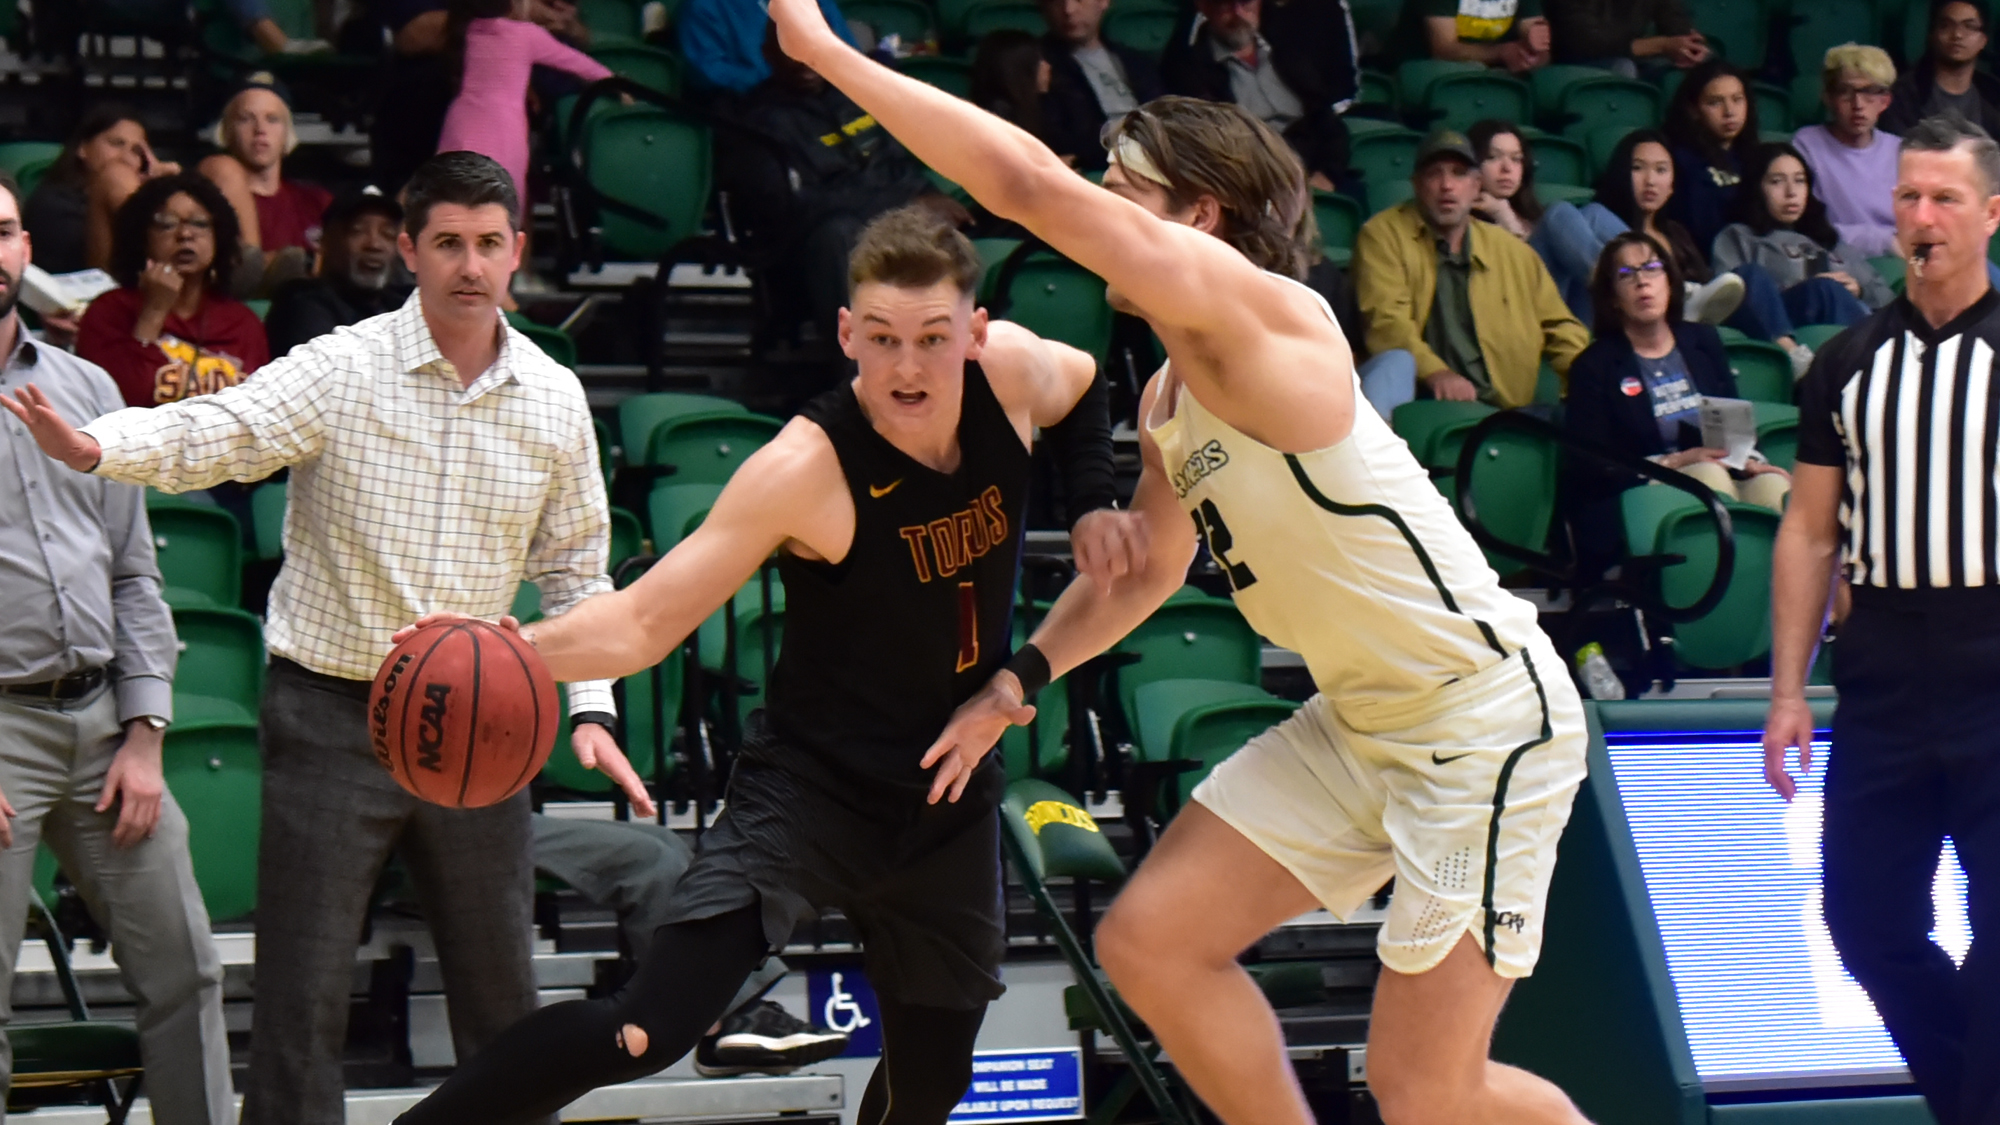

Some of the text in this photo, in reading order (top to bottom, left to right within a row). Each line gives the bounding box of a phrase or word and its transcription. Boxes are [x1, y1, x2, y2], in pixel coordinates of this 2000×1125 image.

[956, 581, 979, 673] 1
[417, 683, 451, 773] NCAA
[972, 1058, 1054, 1073] OMPANION SEAT
[973, 1079, 1047, 1093] WILL BE MADE
[999, 1100, 1030, 1111] UPON
[1031, 1097, 1080, 1109] REQUEST
